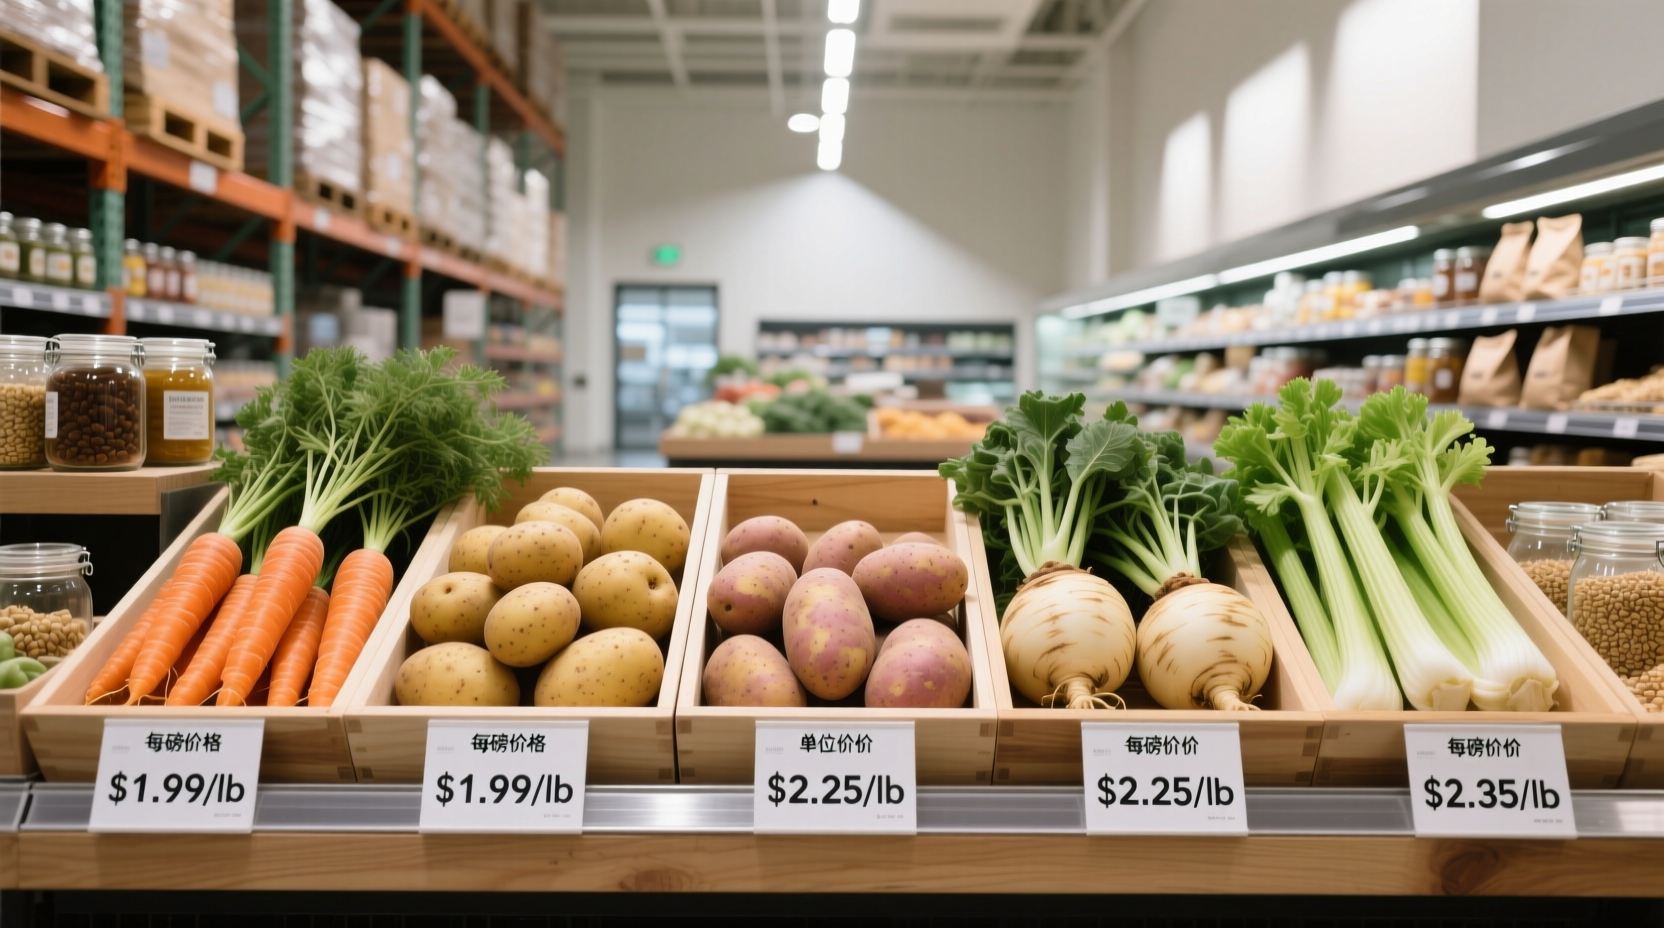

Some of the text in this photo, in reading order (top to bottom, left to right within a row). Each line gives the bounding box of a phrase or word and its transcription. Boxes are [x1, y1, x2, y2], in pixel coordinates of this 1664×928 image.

[799, 733, 873, 754] 单位价价
[108, 771, 245, 806] $1.99/lb
[435, 771, 574, 807] $1.99/lb
[768, 771, 905, 808] $2.25/lb
[1097, 773, 1234, 809] $2.25/lb
[1423, 775, 1560, 811] $2.35/lb
